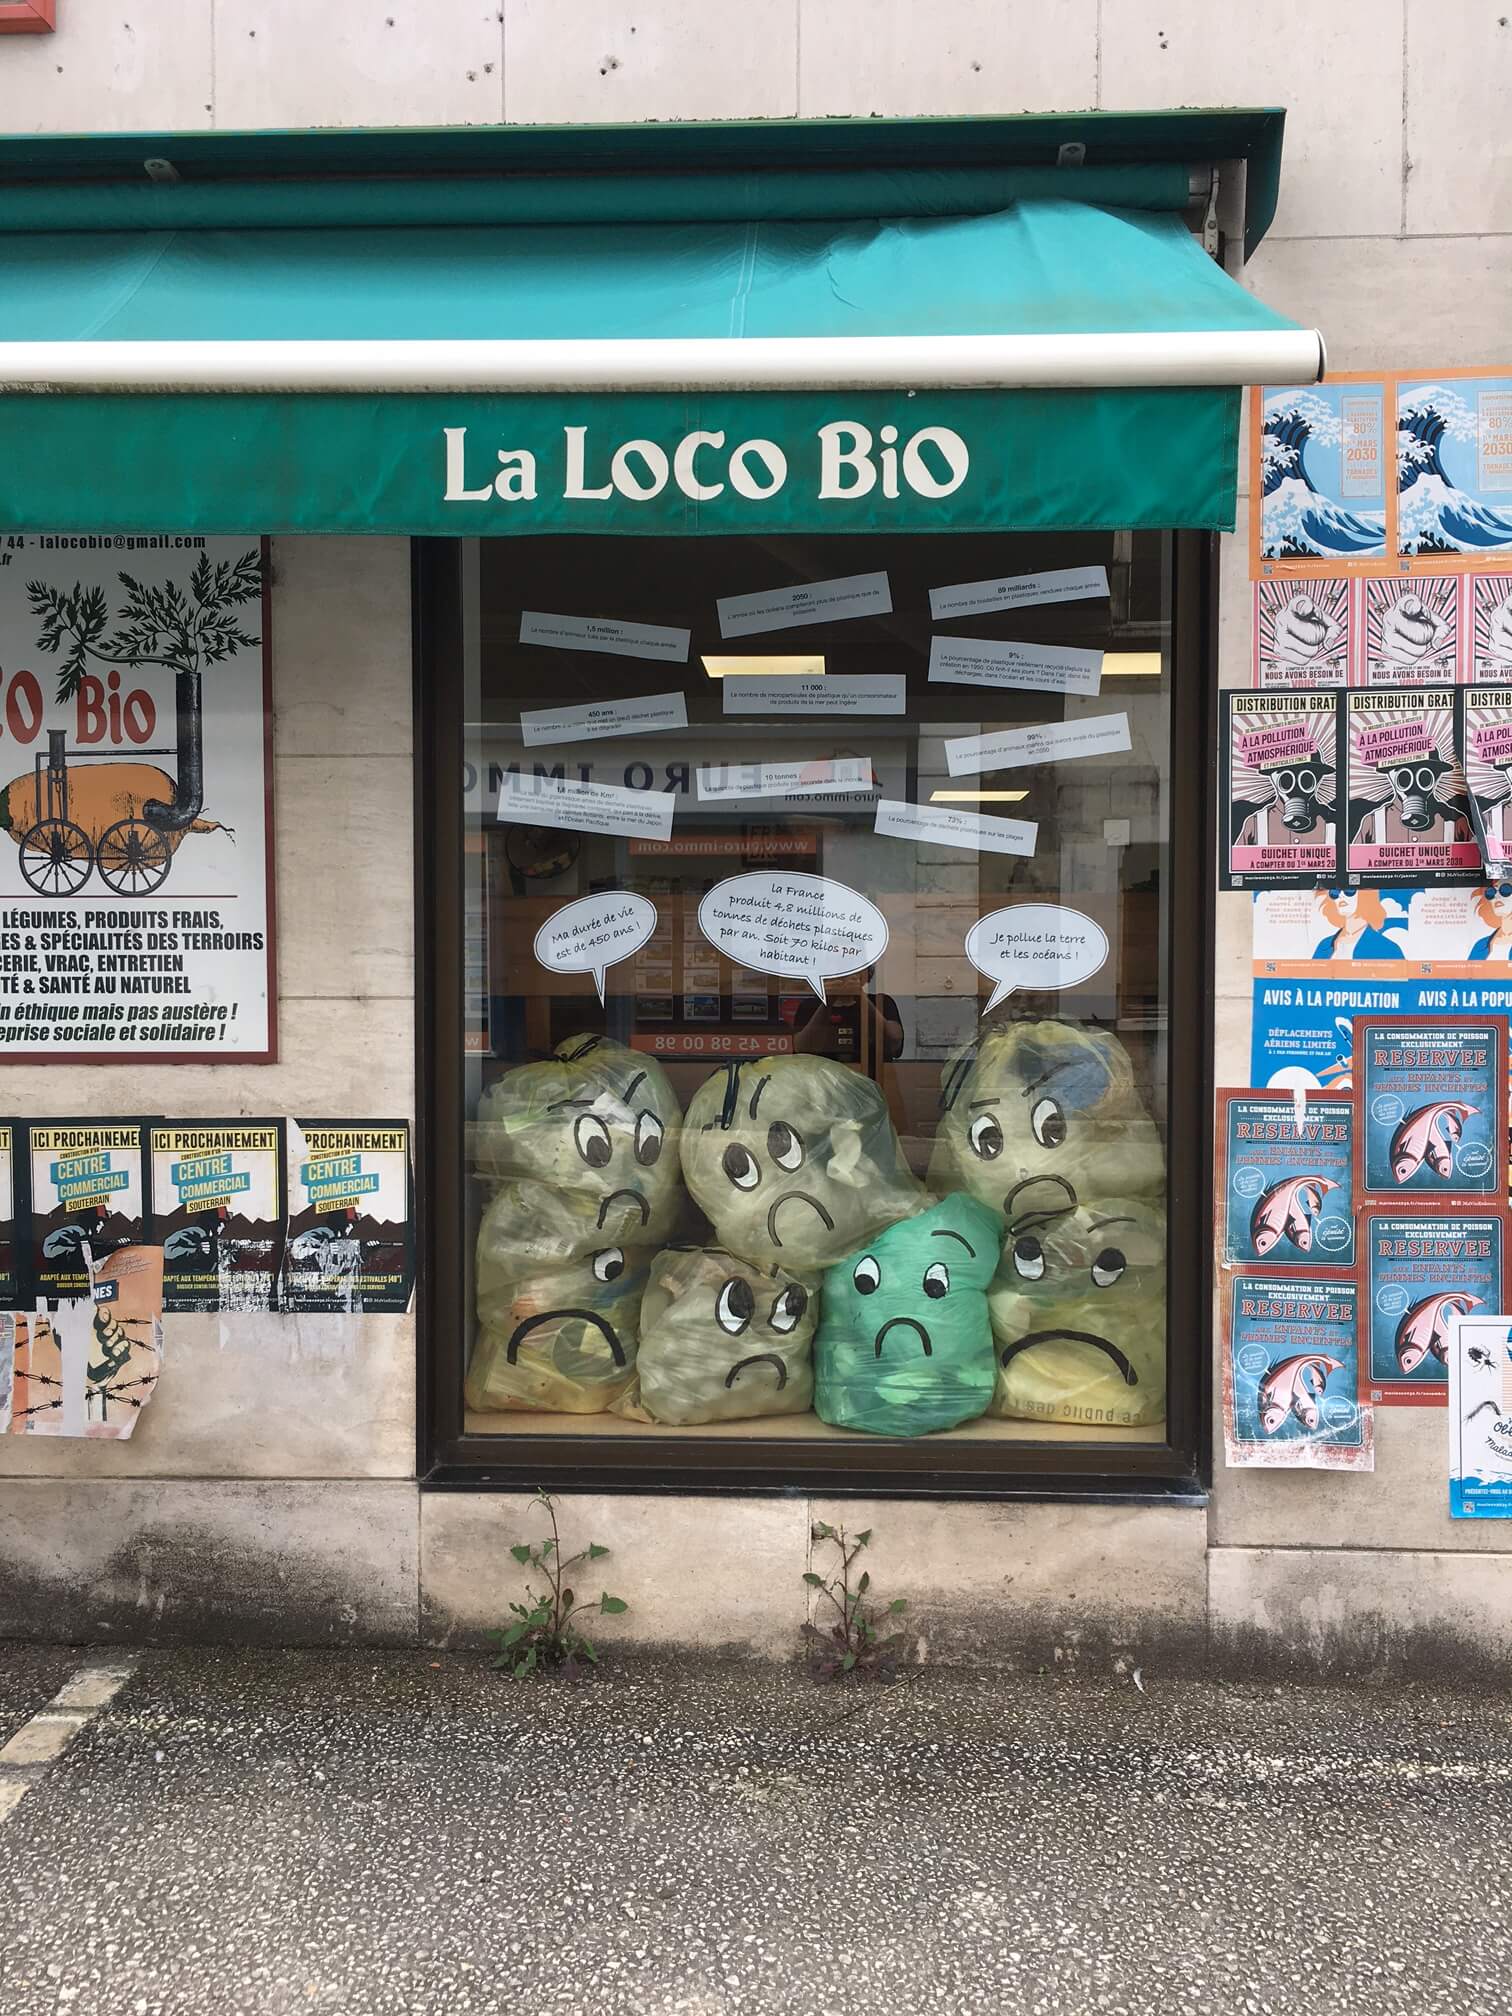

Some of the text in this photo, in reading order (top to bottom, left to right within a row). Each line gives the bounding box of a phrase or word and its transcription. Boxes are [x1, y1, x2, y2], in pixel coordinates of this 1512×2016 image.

[1353, 423, 1376, 434] 80%
[443, 426, 538, 500] La
[1346, 448, 1377, 460] 2030
[7, 534, 206, 550] 44 lalocobio@gmail.com
[792, 592, 809, 602] 2050
[1265, 669, 1344, 680] NOUS AVONS BESOIN DE
[75, 670, 157, 745] Bio
[1236, 696, 1336, 712] DISTRIBUTION GRAT
[1354, 694, 1454, 709] DISTRIBUTION GRAT
[1250, 726, 1305, 747] LA POLLUTION
[1367, 724, 1424, 745] LA POLLUTION
[1261, 847, 1331, 859] GUICHET UNIQUE
[1379, 846, 1450, 858] GUICHET UNIQUE
[1373, 859, 1404, 868] COMPTER
[1404, 858, 1414, 867] DU
[1426, 858, 1445, 867] MARS
[786, 885, 825, 901] France
[729, 893, 862, 923] produit 4,8 millions de
[3, 907, 224, 930] LÉGUMES, PRODUITS FRAIS,
[551, 906, 635, 944] Ma durée de vie
[713, 908, 873, 942] tonnes de déchets plastiques
[24, 935, 37, 950] &
[40, 929, 143, 951] SPÉCIALITÉS
[147, 932, 178, 951] DES
[182, 932, 264, 951] TERROIRS
[556, 948, 572, 961] est
[574, 942, 587, 954] de
[588, 932, 611, 948] 450
[613, 927, 634, 940] ans
[719, 926, 863, 957] par an. Soit 70 kilos par
[989, 933, 1005, 945] Je
[1006, 932, 1042, 948] pollue
[1059, 934, 1086, 945] terre
[759, 948, 811, 966] habitant
[1000, 950, 1010, 959] et
[1013, 949, 1029, 960] les
[1032, 948, 1072, 960] océans
[45, 954, 183, 974] VRAC, ENTRETIEN
[23, 978, 36, 994] &
[39, 972, 91, 994] SANTÉ
[94, 976, 116, 994] AU
[120, 976, 192, 994] NATUREL
[1263, 987, 1400, 1009] AVIS À LA POPULATION
[1418, 990, 1447, 1007] AVIS
[1450, 988, 1459, 1007] À
[1464, 991, 1478, 1007] LA
[14, 1002, 239, 1022] éthique mais pas austère !
[53, 1023, 116, 1041] sociale
[119, 1024, 136, 1041] et
[139, 1023, 216, 1041] solidaire
[219, 1023, 226, 1041] !
[1268, 1027, 1333, 1039] DÉPLACEMENTS
[1264, 1038, 1337, 1050] AÉRIENS LIMITÉS
[1374, 1050, 1488, 1067] RESERVEE
[33, 1130, 141, 1148] ICI PROCHAINEME
[154, 1132, 275, 1149] ICI PROCHAINEMENT
[304, 1133, 404, 1150] PROCHAINEMENT
[57, 1155, 107, 1180] CENTRE
[178, 1156, 228, 1181] CENTRE
[308, 1157, 358, 1181] CENTRE
[60, 1173, 127, 1198] COMMERCIAL
[180, 1174, 248, 1199] COMMERCIAL
[310, 1176, 377, 1200] COMMERCIAL
[68, 1194, 110, 1211] SOUTERRAIN
[189, 1195, 231, 1211] SOUTERRAIN
[318, 1196, 360, 1212] SOUTERRAIN
[1378, 1240, 1492, 1257] RESERVEE
[1241, 1299, 1353, 1321] RESERVEE
